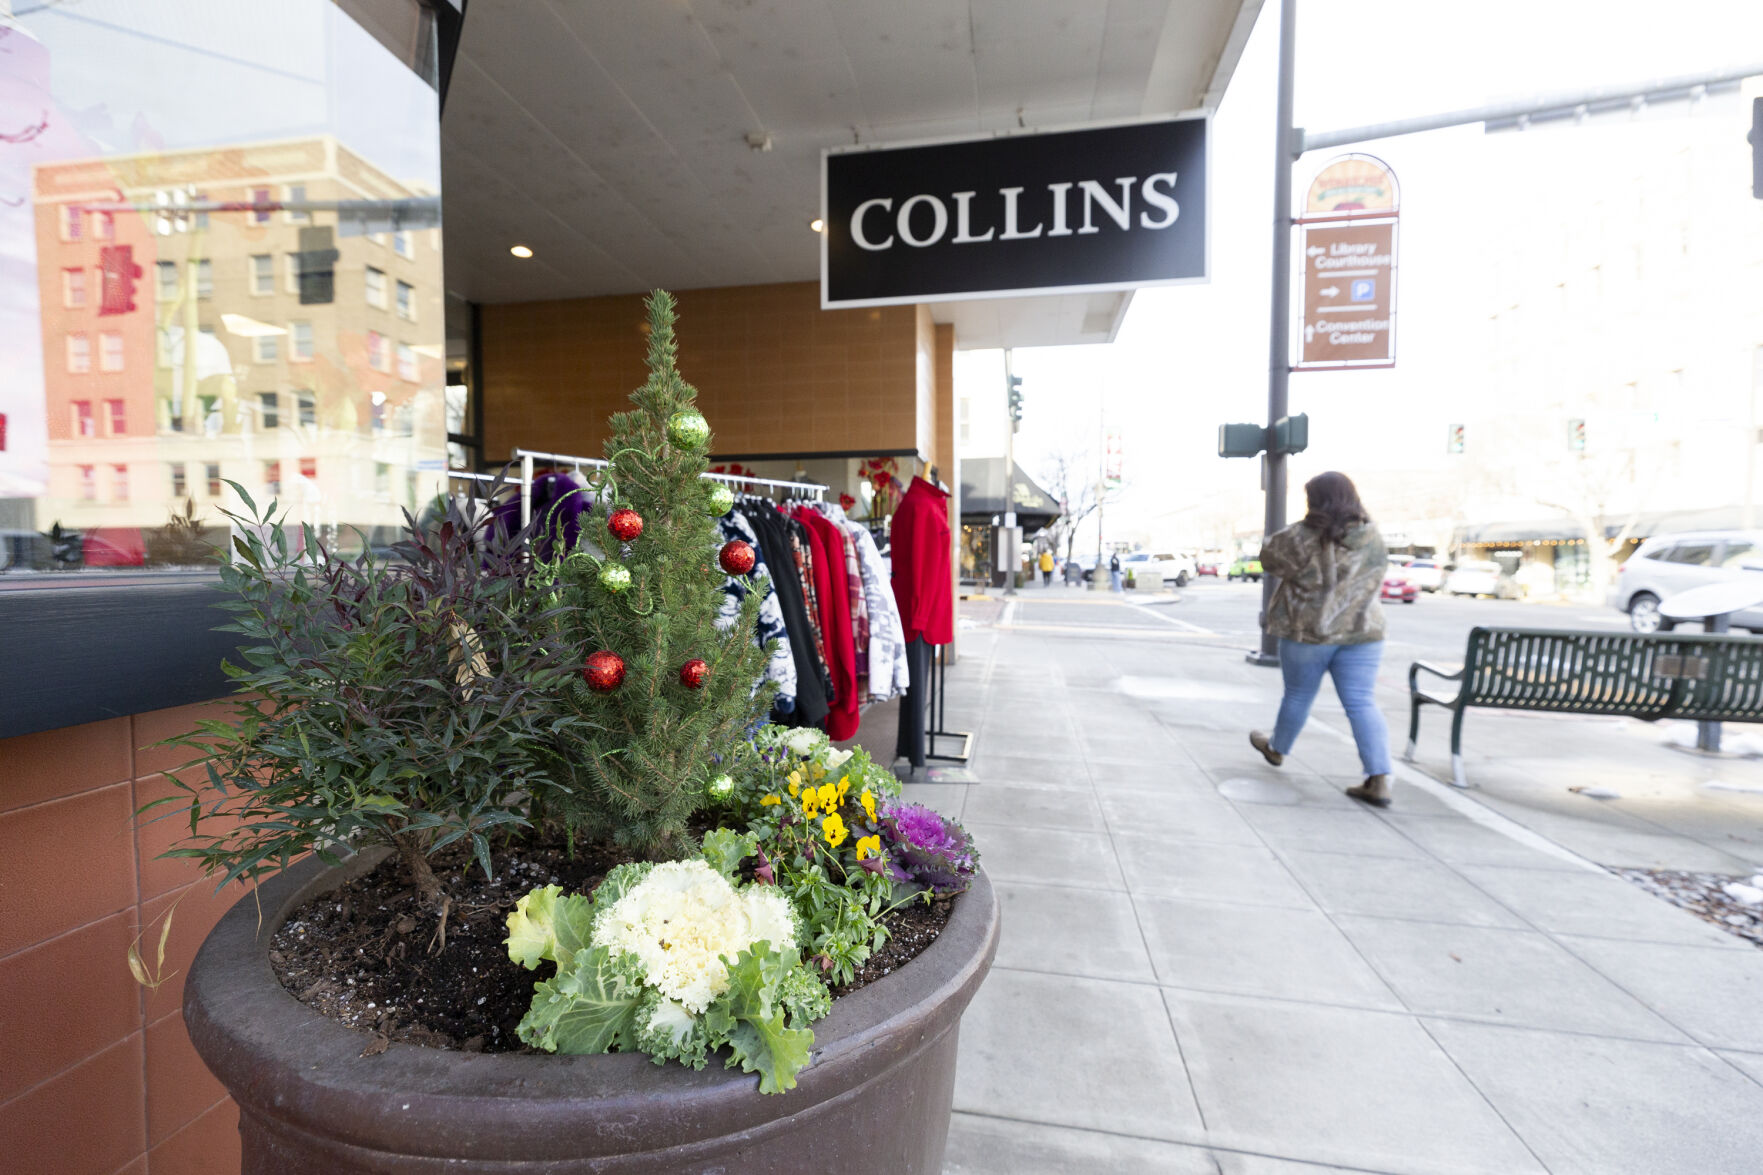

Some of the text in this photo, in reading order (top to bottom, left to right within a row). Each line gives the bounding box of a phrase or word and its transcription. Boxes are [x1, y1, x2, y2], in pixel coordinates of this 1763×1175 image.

[850, 172, 1180, 251] COLLINS
[1330, 242, 1377, 256] Library
[1315, 254, 1391, 270] Courthouse
[1356, 282, 1370, 297] P
[1315, 318, 1390, 333] Convention
[1329, 331, 1375, 345] Center
